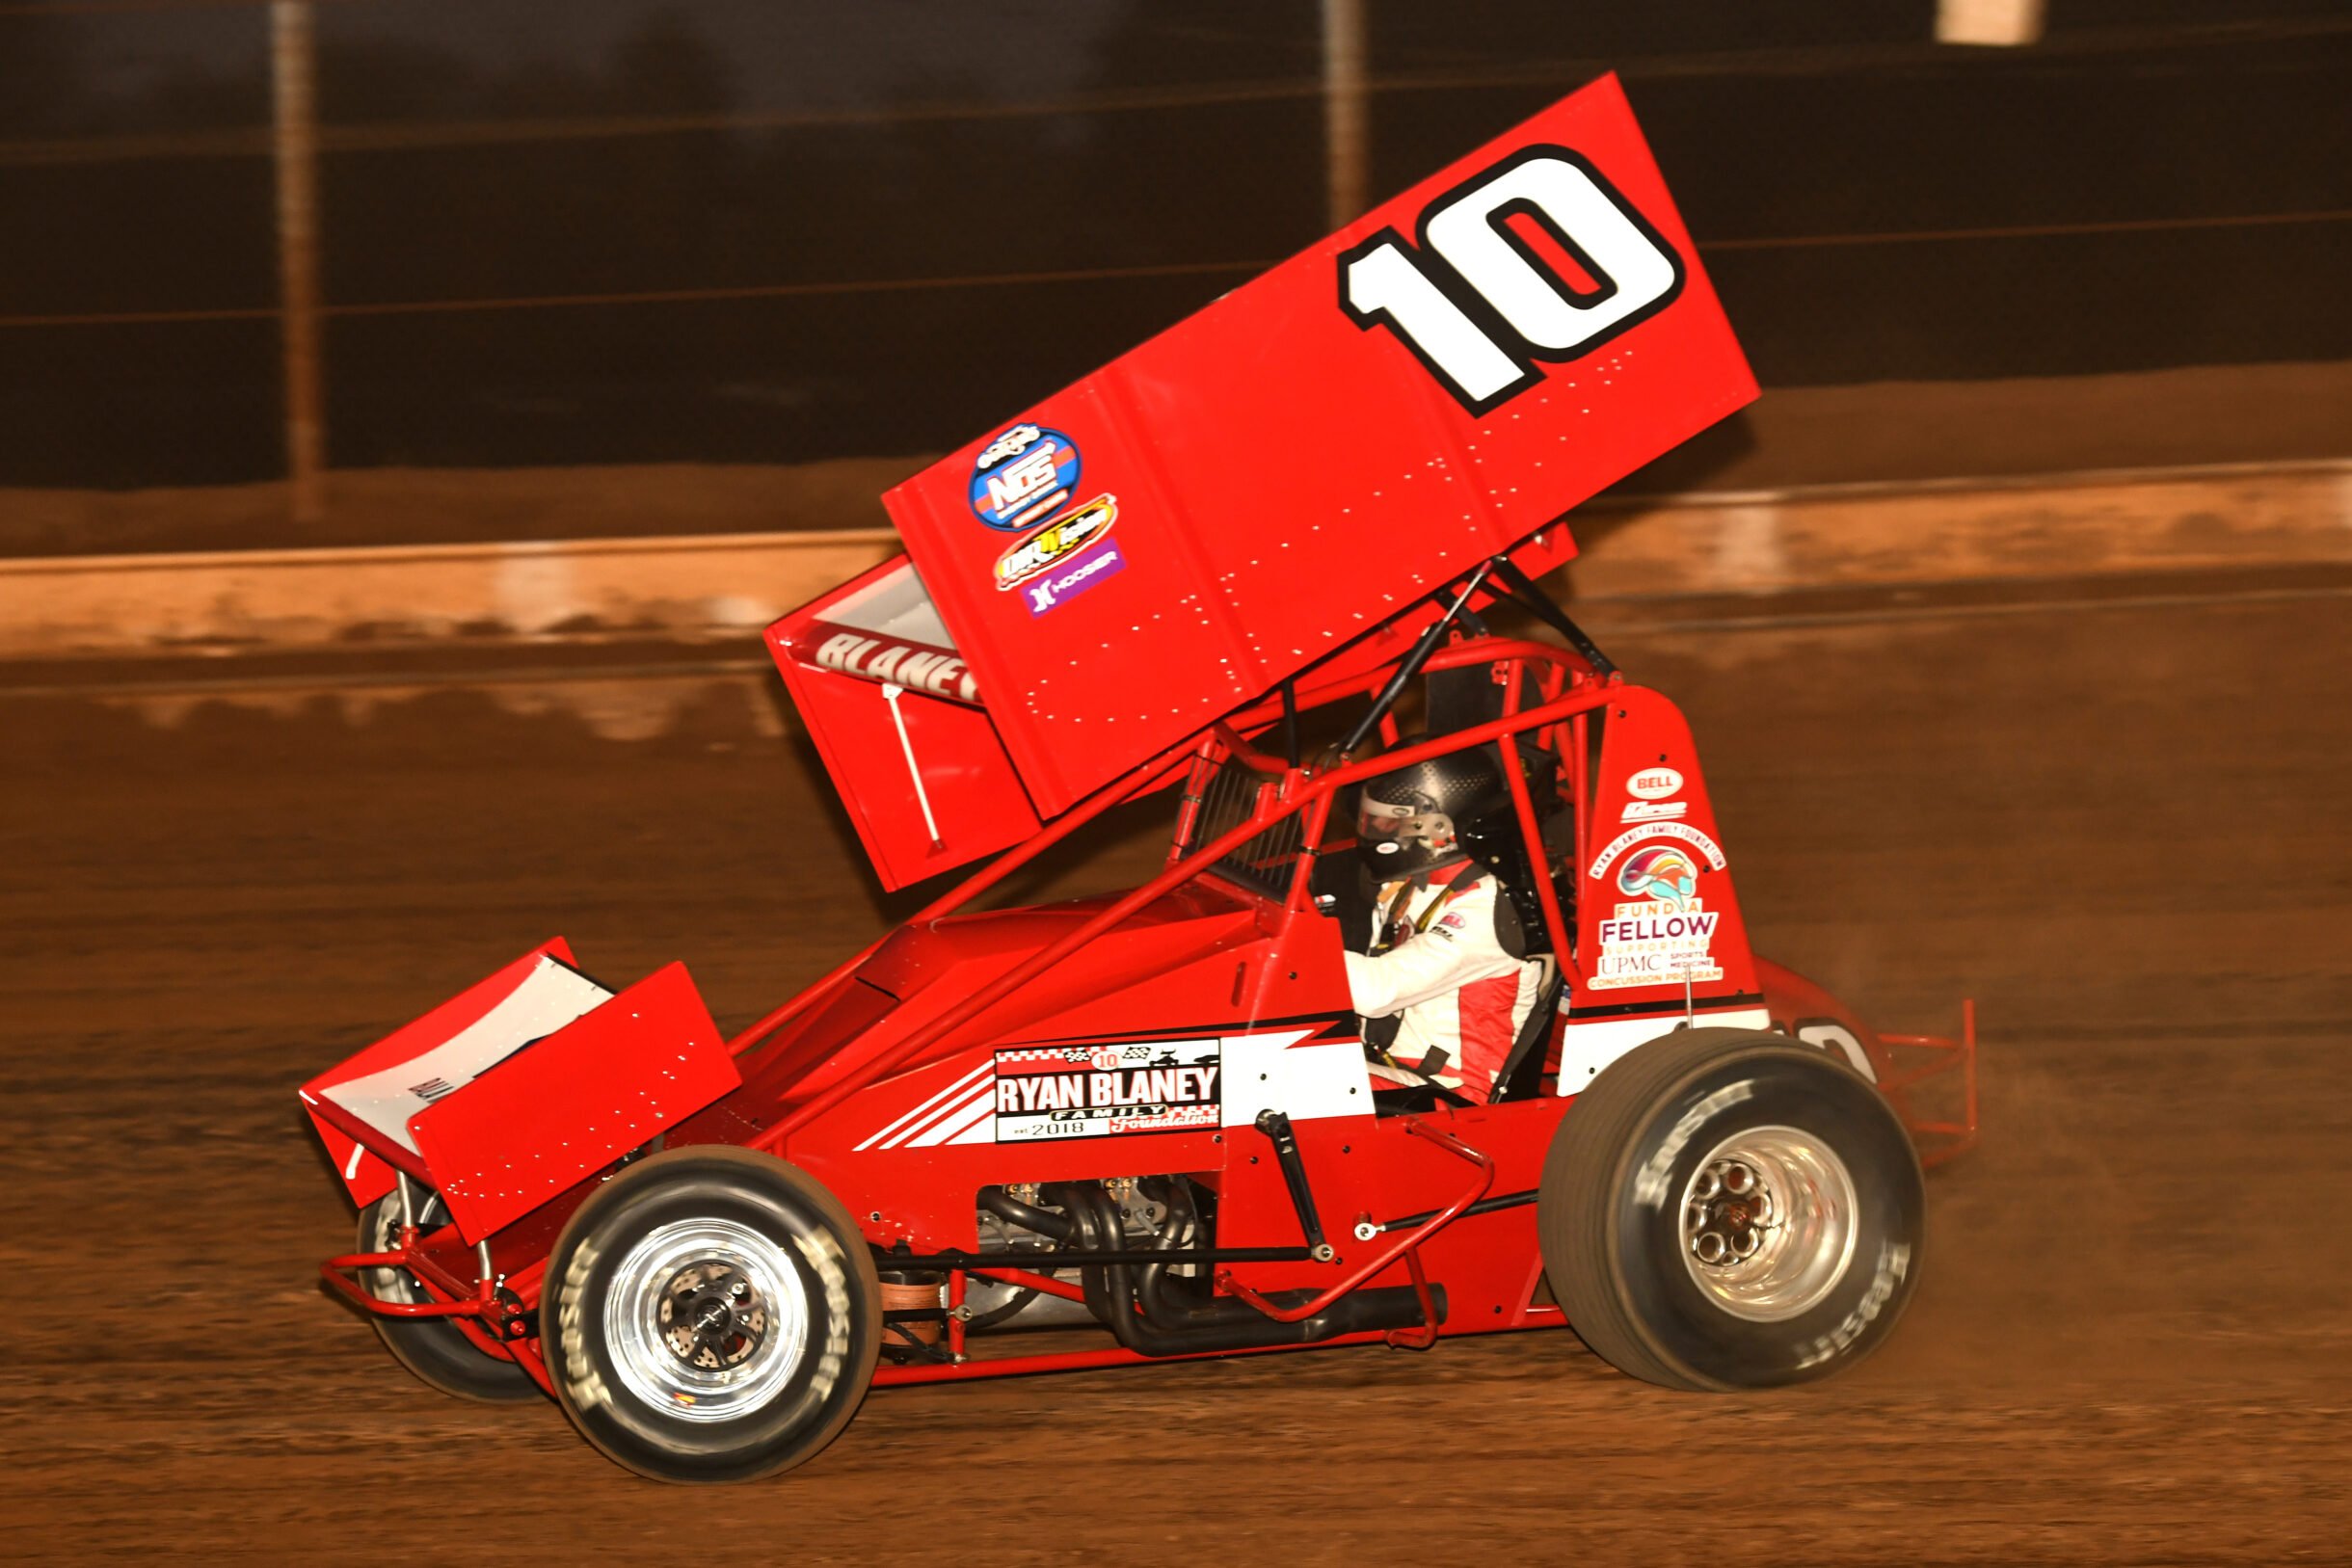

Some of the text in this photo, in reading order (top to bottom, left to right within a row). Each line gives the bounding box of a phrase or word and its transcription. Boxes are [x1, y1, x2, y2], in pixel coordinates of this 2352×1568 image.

[1344, 151, 1680, 409] 10
[1636, 775, 1674, 789] BELL
[1592, 823, 1724, 876] RYAN BLANEY FAMILY FOUNDATION
[1616, 901, 1701, 919] FUND A
[1602, 915, 1714, 943] FELLOW
[1605, 940, 1708, 955] SUPPORTING
[1600, 950, 1704, 974] UPMC SPORTS
[1670, 959, 1712, 969] MEDICINE
[1589, 970, 1723, 989] CONCUSSION PROGRAM
[1099, 1053, 1118, 1068] 10
[998, 1066, 1219, 1112] RYAN BLANEY
[1054, 1106, 1167, 1121] FAMILY
[1110, 1110, 1219, 1133] Foundation
[1031, 1122, 1084, 1136] 2018
